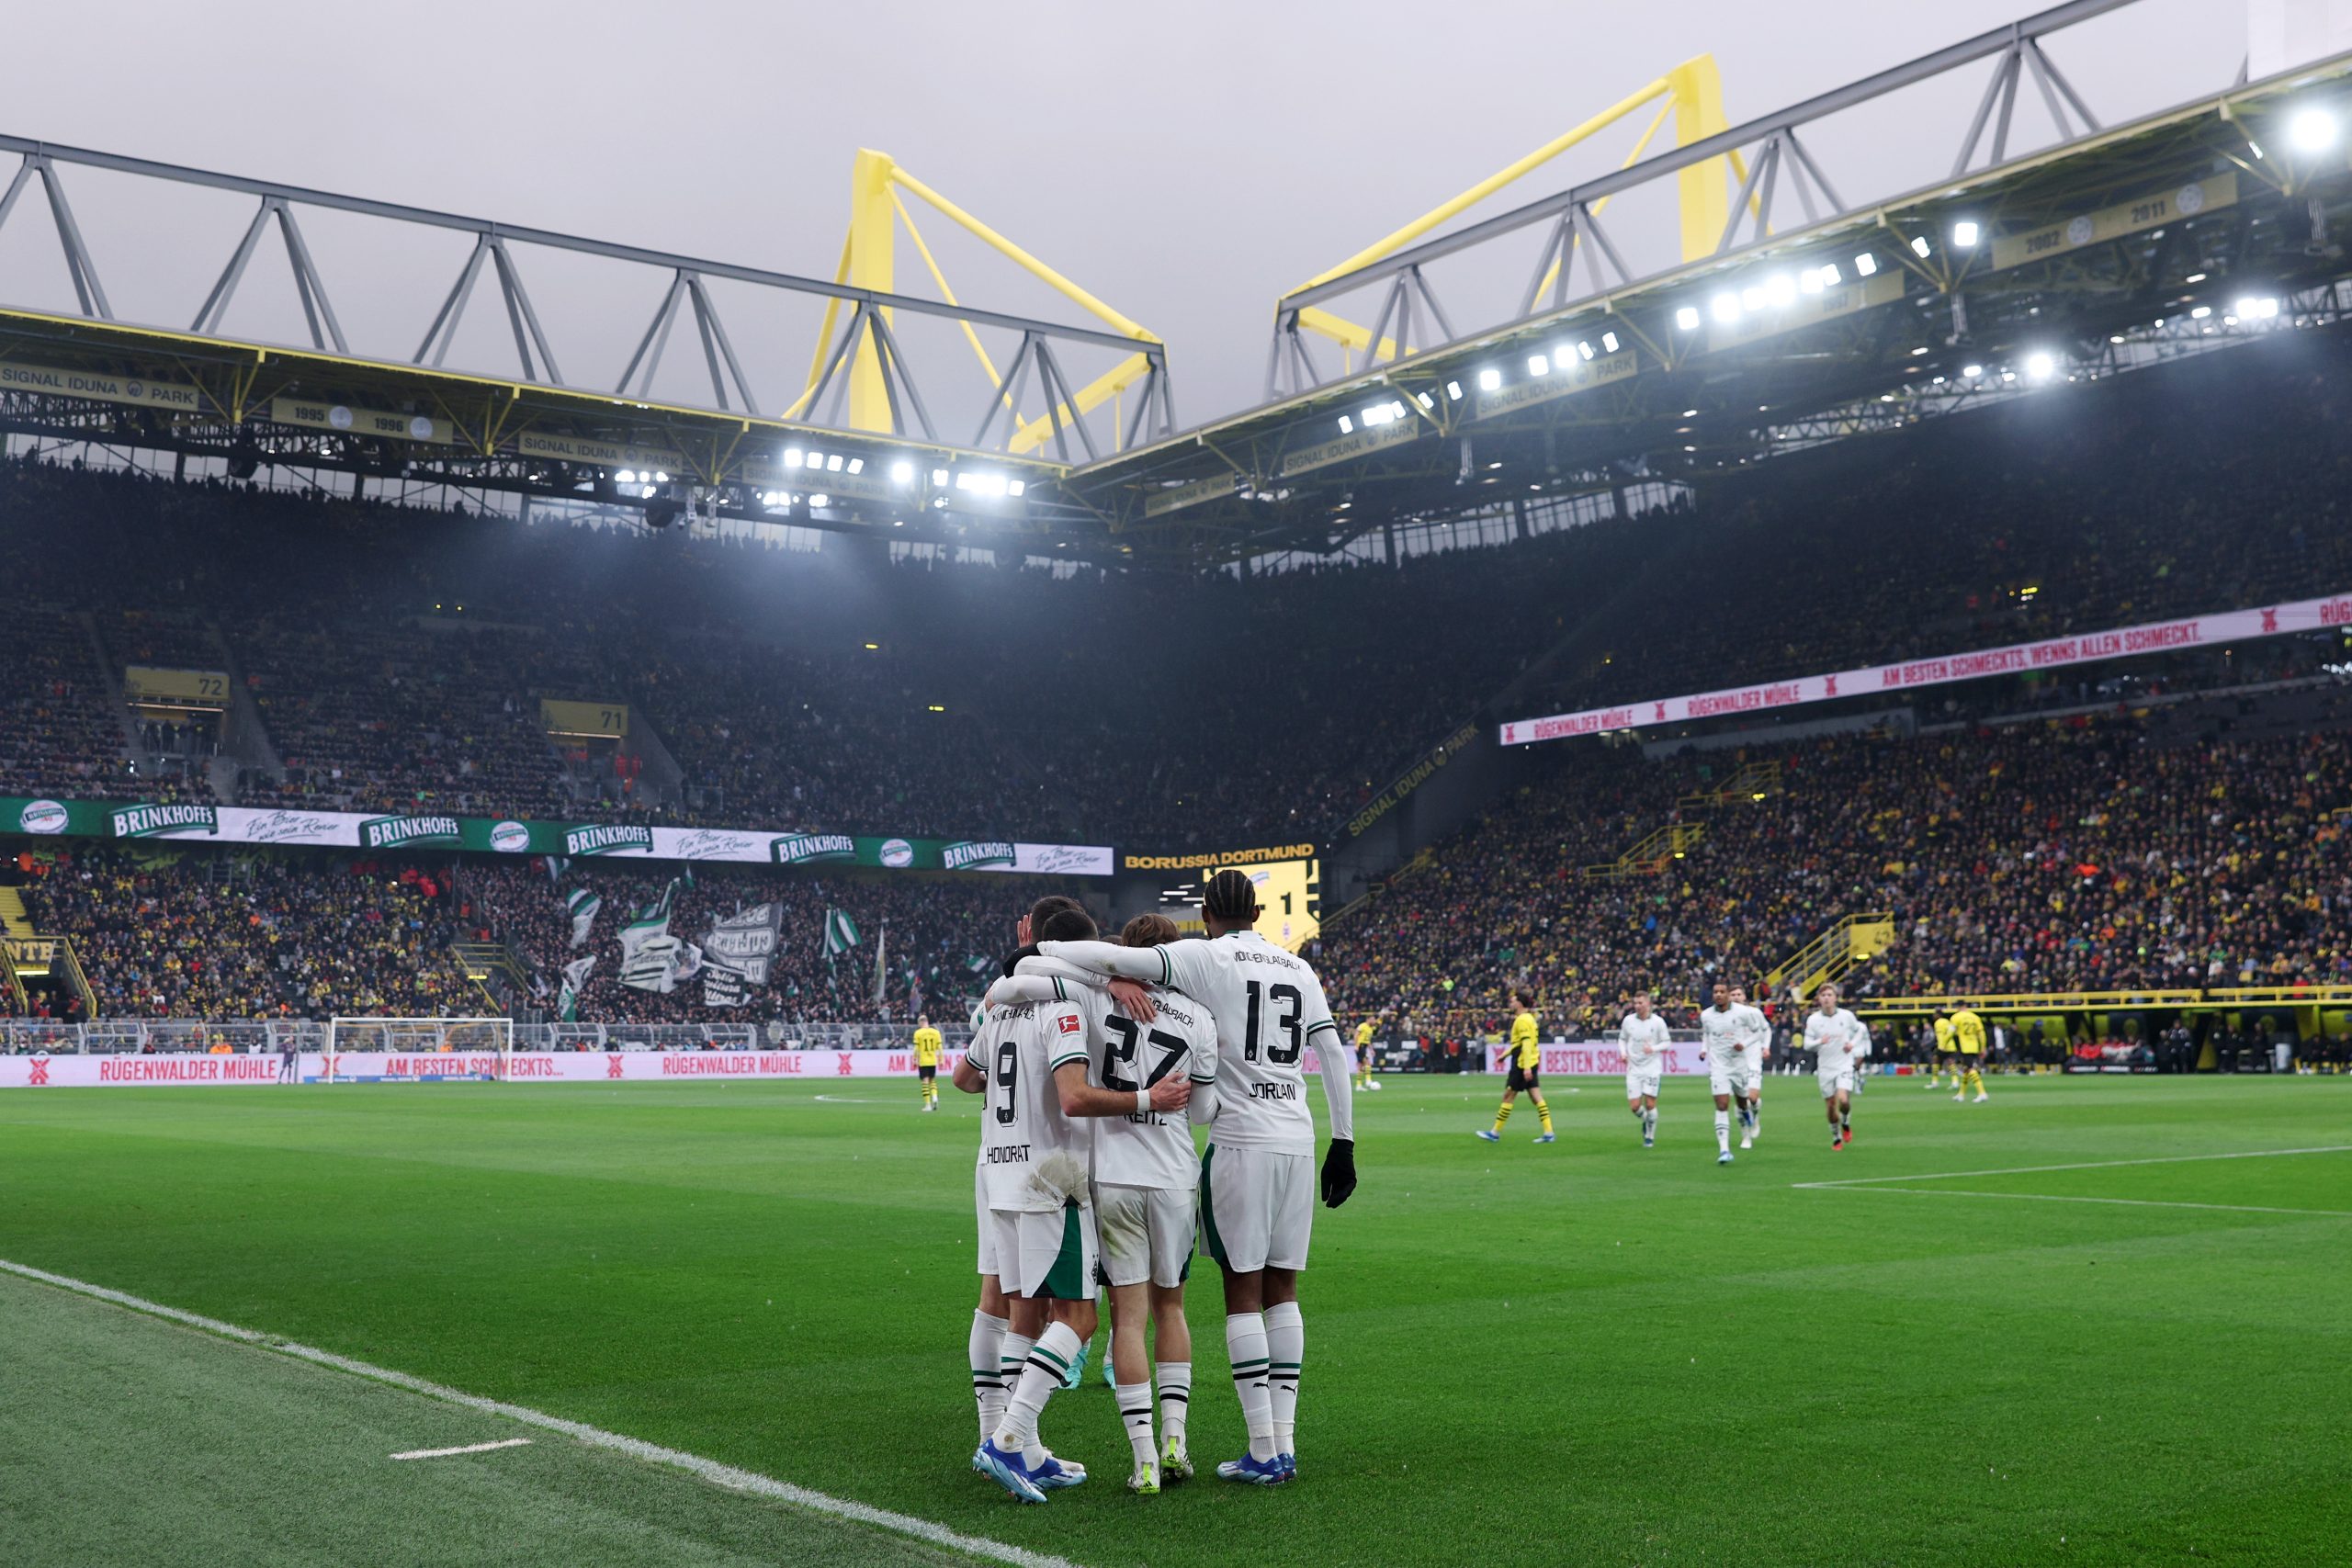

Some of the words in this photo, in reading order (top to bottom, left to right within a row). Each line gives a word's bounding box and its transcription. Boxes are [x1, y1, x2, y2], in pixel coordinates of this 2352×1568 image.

[2025, 231, 2061, 254] 2002
[2131, 200, 2166, 224] 2011
[1, 367, 63, 389] SIGNAL
[68, 377, 119, 396] IDUNA
[151, 388, 194, 404] PARK
[1480, 389, 1527, 413] SIGNAL
[1529, 377, 1570, 400] IDUNA
[1596, 355, 1634, 379] PARK
[294, 406, 325, 422] 1995
[374, 417, 404, 433] 1996
[524, 437, 574, 456] SIGNAL
[577, 446, 618, 461] IDUNA
[644, 453, 679, 468] PARK
[1285, 449, 1327, 471] SIGNAL
[1327, 438, 1363, 458] IDUNA
[1383, 423, 1415, 443] PARK
[747, 468, 794, 485] SIGNAL
[795, 474, 831, 489] IDUNA
[1883, 666, 1901, 687] AM
[1903, 660, 1949, 683] BESTEN
[2029, 640, 2077, 665] WENNS
[2079, 633, 2122, 659] ALLEN
[198, 678, 223, 696] 72
[1688, 689, 1761, 716] RÜGENWALDER
[1763, 683, 1801, 707] MÜHLE
[601, 710, 622, 730] 71
[1533, 714, 1600, 740] RÜGENWALDER
[1600, 708, 1634, 730] MÜHLE
[1348, 793, 1397, 838] SIGNAL
[1393, 759, 1436, 799] IDUNA
[1445, 721, 1480, 756] PARK
[1125, 853, 1220, 870] BORUSSIA
[1221, 843, 1315, 865] DORTMUND
[1280, 892, 1292, 916] 1
[1245, 980, 1306, 1068] 13
[923, 1038, 935, 1052] 11
[1102, 1014, 1193, 1092] 27
[100, 1056, 219, 1081] RÜGENWALDER
[223, 1055, 277, 1080] MÜHLE
[386, 1057, 408, 1076] AM
[413, 1057, 466, 1076] BESTEN
[662, 1054, 755, 1075] RÜGENWALDER
[760, 1052, 802, 1074] MÜHLE
[888, 1055, 906, 1072] AM
[1545, 1050, 1593, 1073] BESTEN
[997, 1042, 1018, 1128] 9
[1249, 1082, 1296, 1101] JORDAN
[987, 1145, 1031, 1165] HONORAT
